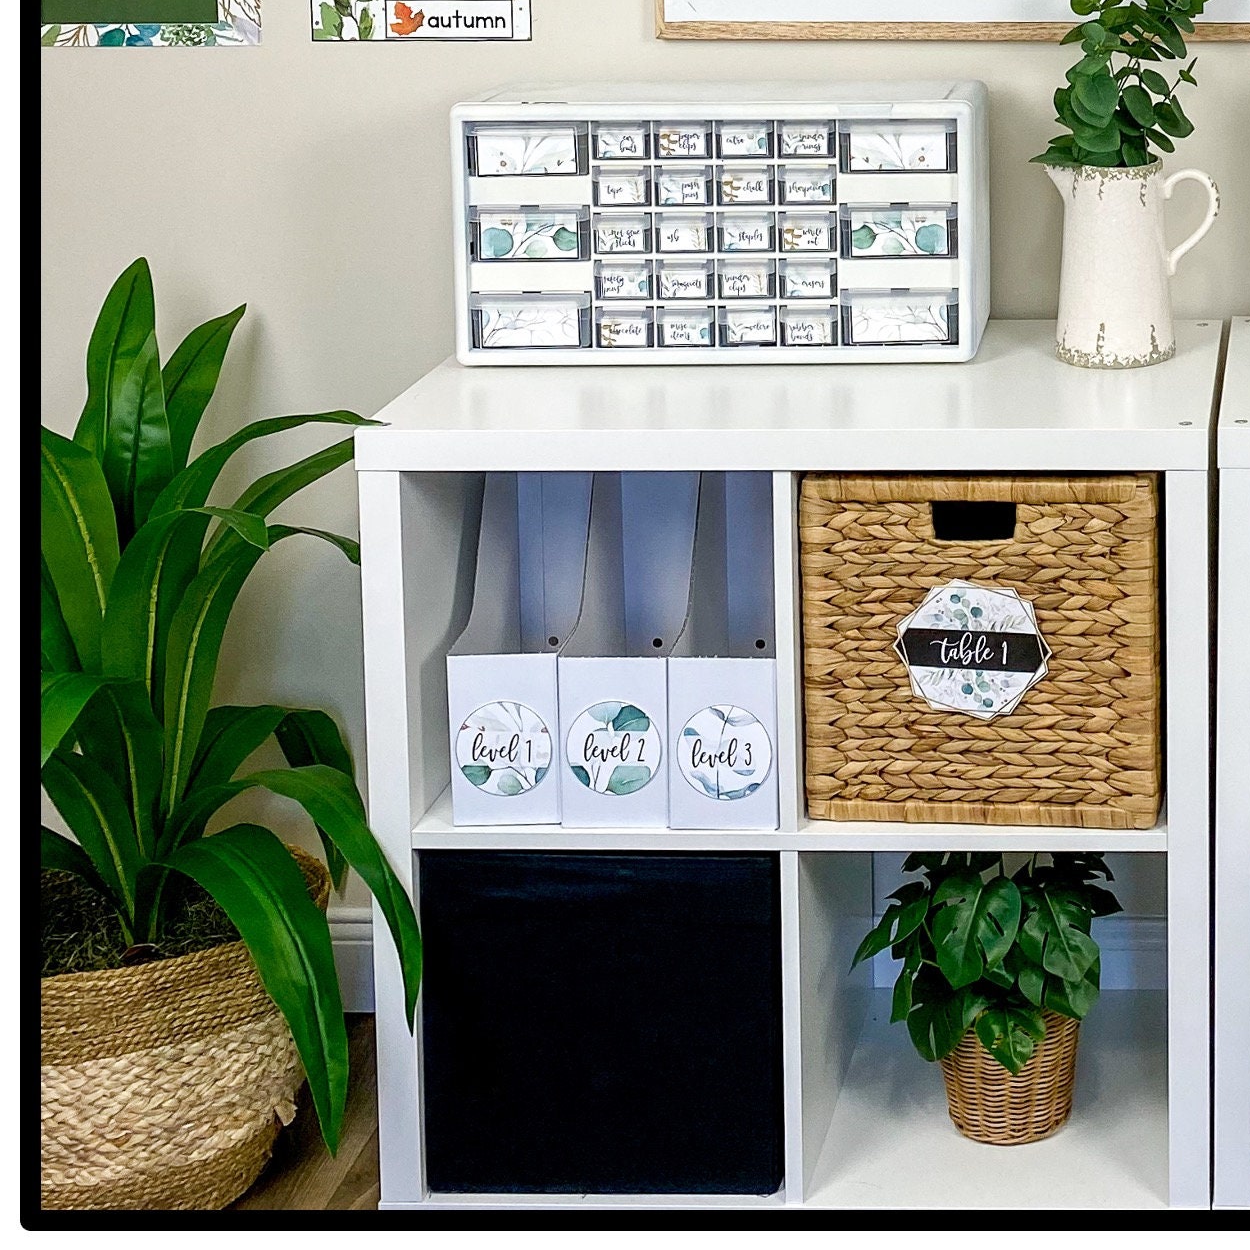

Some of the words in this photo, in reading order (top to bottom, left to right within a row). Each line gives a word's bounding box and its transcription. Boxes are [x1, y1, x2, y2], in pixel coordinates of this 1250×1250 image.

[427, 11, 506, 31] autumn
[742, 180, 764, 193] chalk
[738, 231, 763, 246] staples
[931, 632, 994, 664] table
[1002, 641, 1009, 665] 1
[472, 733, 519, 762] level
[526, 739, 533, 763] 1
[583, 731, 629, 762] level
[633, 734, 646, 762] 2
[691, 738, 738, 768] level
[743, 737, 753, 765] 3
